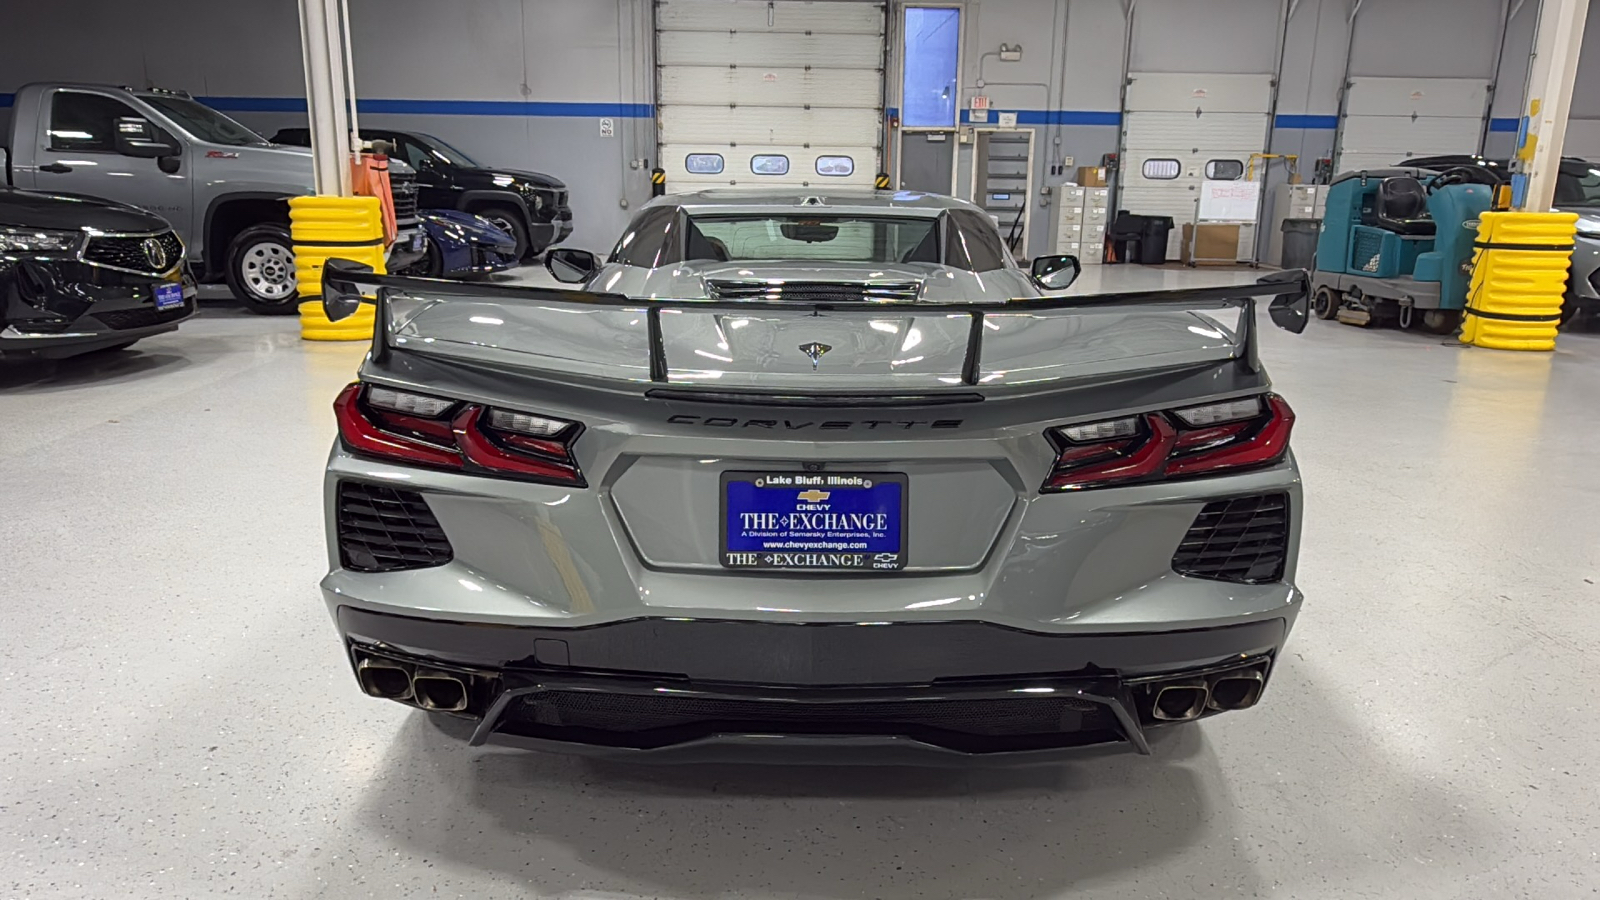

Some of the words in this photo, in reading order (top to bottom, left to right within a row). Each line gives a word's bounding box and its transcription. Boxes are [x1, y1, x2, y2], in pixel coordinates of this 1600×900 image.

[974, 96, 987, 107] EXIT
[667, 414, 964, 430] CORVETTE
[766, 475, 792, 485] Lake
[795, 476, 824, 485] Bluff,
[827, 476, 863, 485] Illinois
[740, 512, 779, 530] THE
[789, 513, 888, 530] EXCHANGE
[763, 541, 868, 550] www.chevyexchange.com
[726, 553, 758, 565] THE
[773, 554, 864, 566] EXCHANGE
